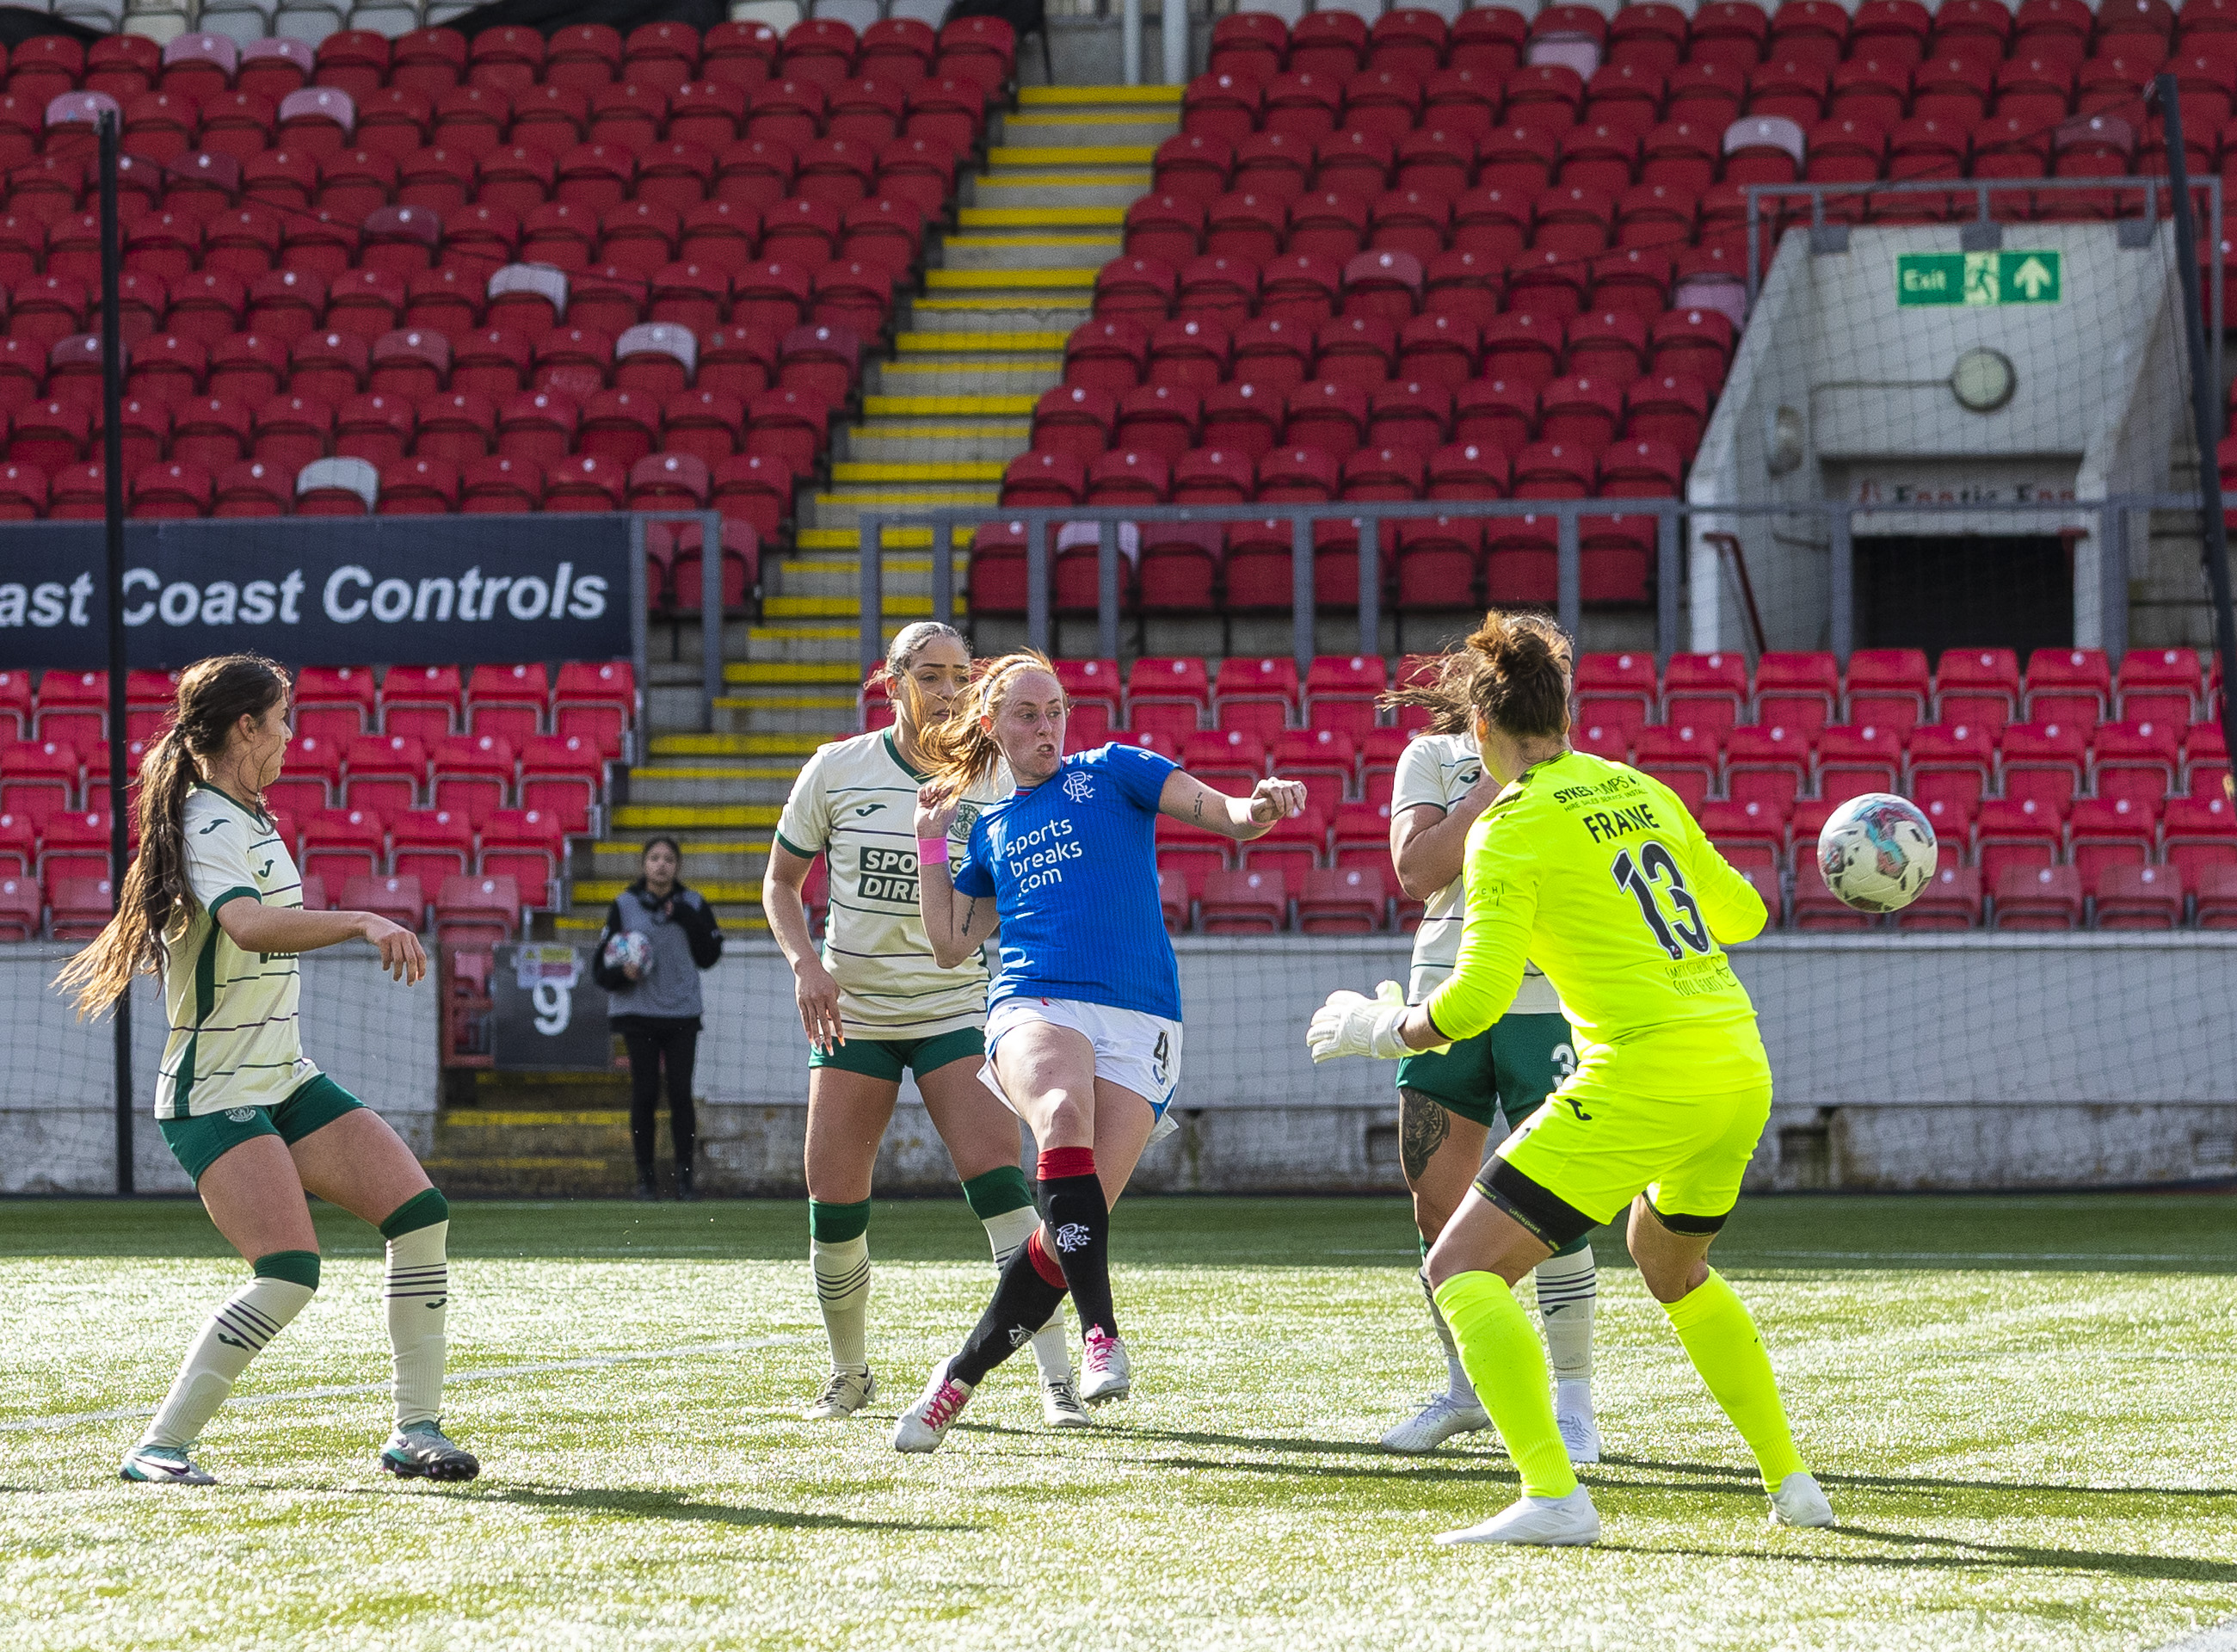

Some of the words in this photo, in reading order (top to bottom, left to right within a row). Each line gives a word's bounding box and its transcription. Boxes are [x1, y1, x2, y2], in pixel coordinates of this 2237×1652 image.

[1903, 268, 1946, 292] Exit
[0, 571, 95, 627] ast
[122, 567, 306, 627] Coast
[322, 562, 609, 624] Controls
[1553, 786, 1593, 804] SYKES
[1564, 801, 1581, 812] HIRE
[1005, 818, 1073, 857] sports
[1010, 841, 1082, 878] breaks
[1610, 839, 1711, 961] 13
[533, 979, 572, 1036] 9
[1153, 1030, 1169, 1071] 4
[1550, 1042, 1576, 1088] 3
